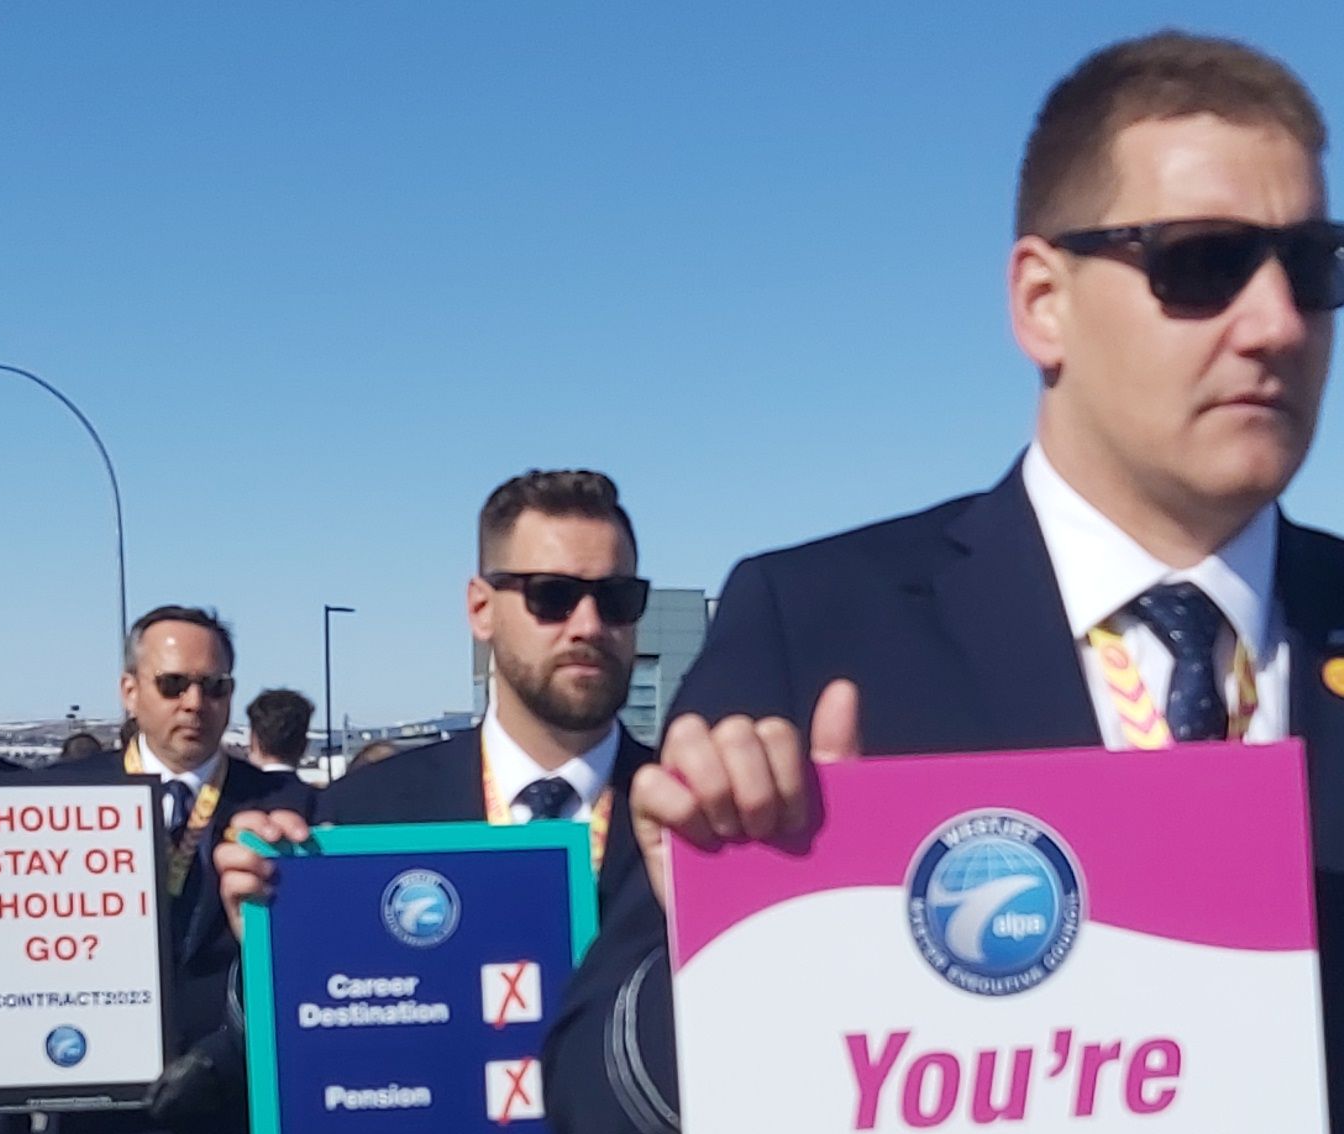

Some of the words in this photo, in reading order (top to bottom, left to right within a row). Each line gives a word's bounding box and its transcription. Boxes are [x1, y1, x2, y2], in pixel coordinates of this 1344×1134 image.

[136, 804, 144, 831] I
[85, 848, 135, 875] OR
[140, 891, 148, 917] I
[26, 934, 99, 962] GO?
[327, 974, 420, 1000] Career
[298, 1000, 450, 1028] Destination
[843, 1029, 1182, 1130] You're
[324, 1083, 432, 1111] Pension
